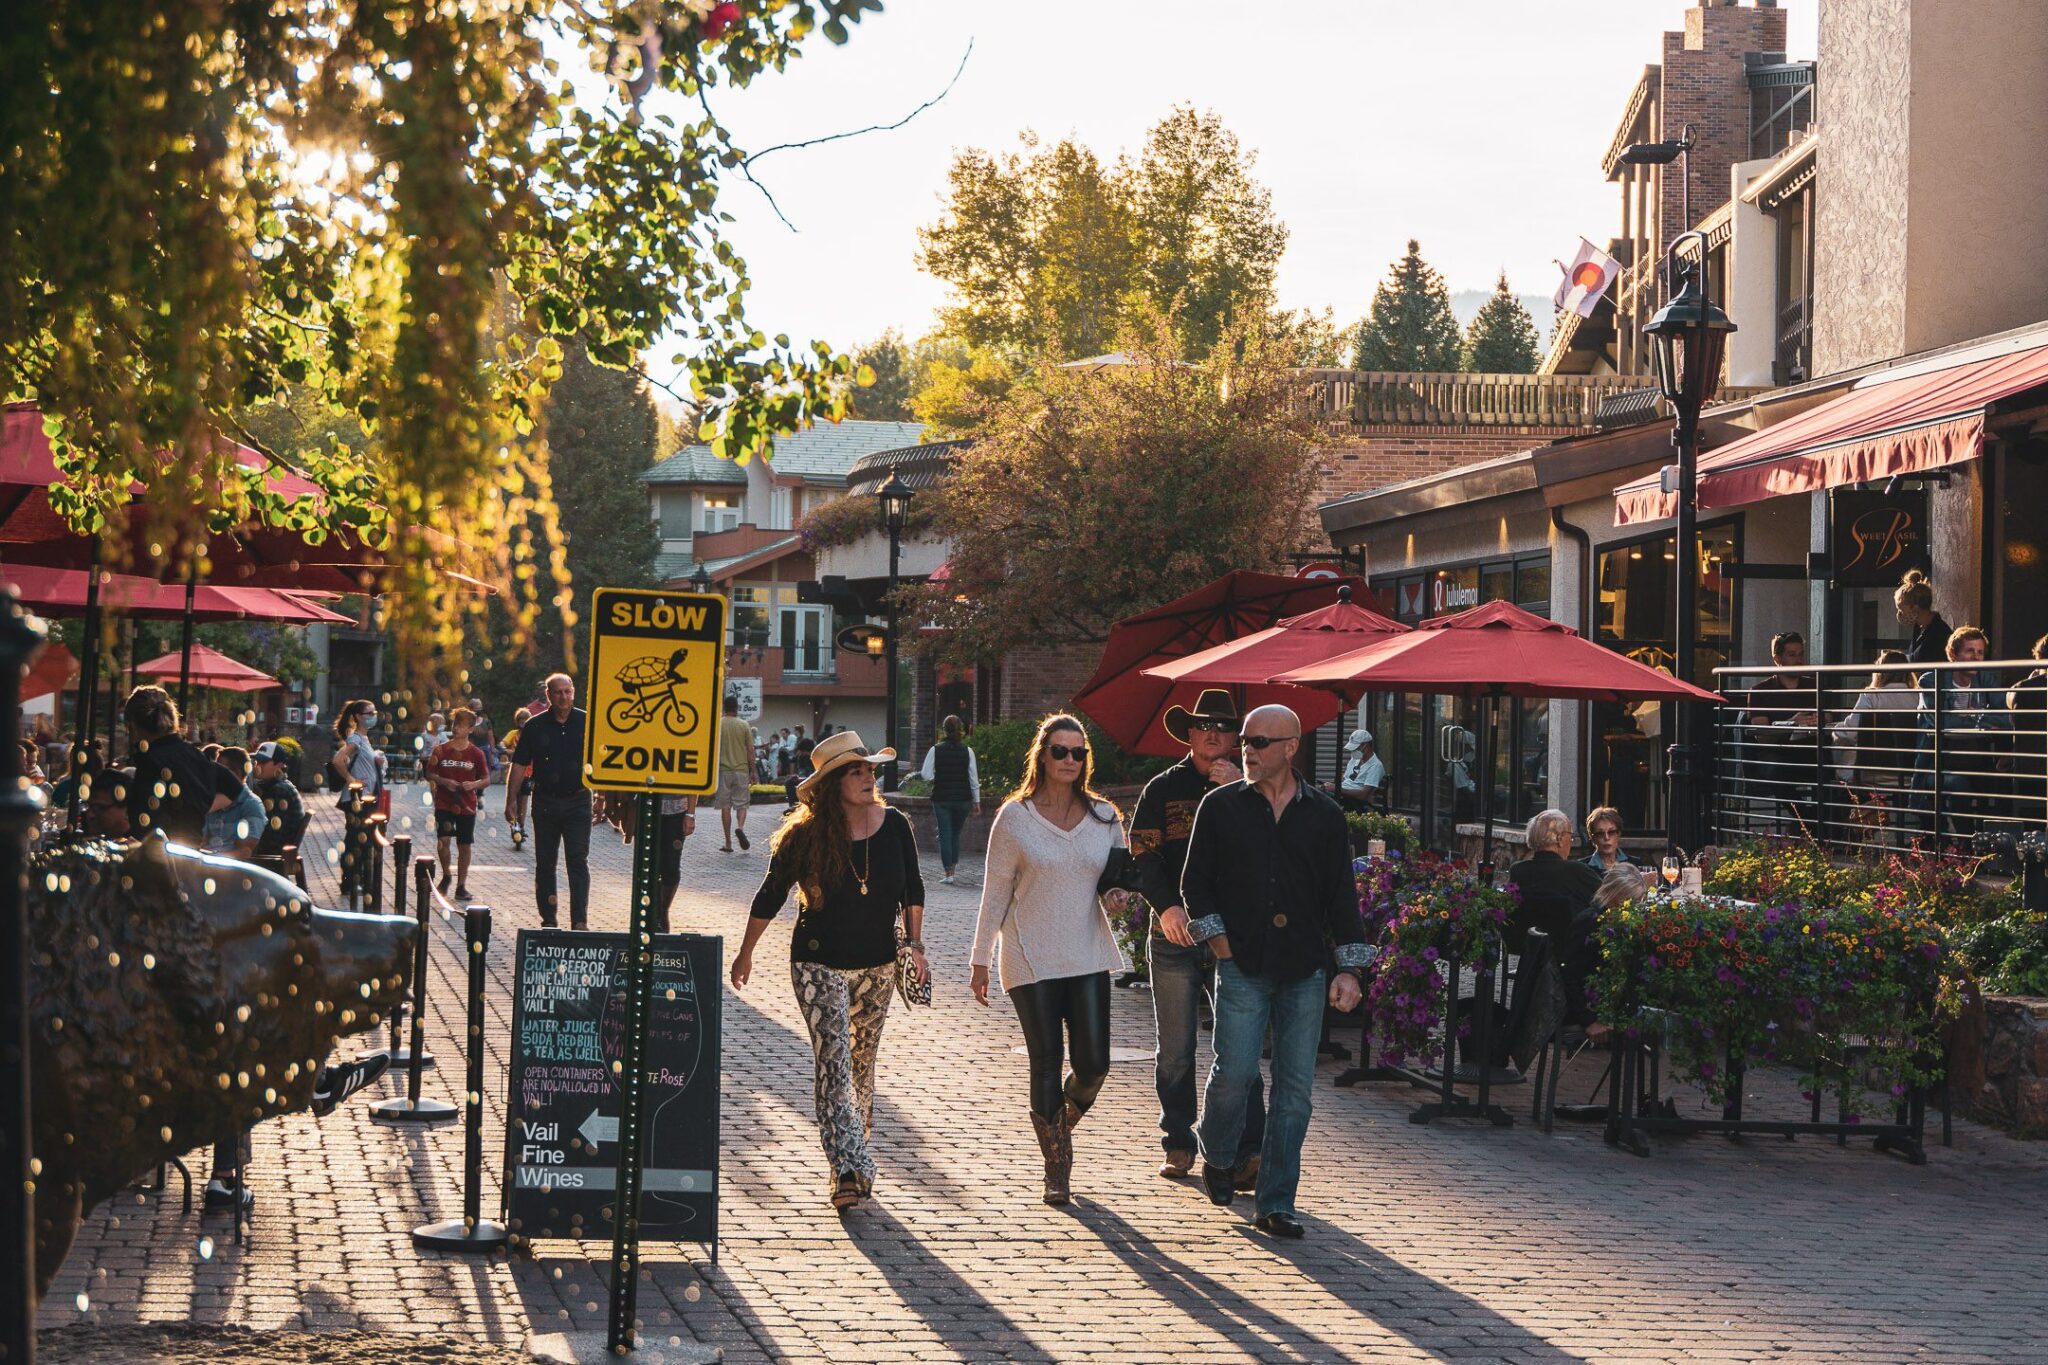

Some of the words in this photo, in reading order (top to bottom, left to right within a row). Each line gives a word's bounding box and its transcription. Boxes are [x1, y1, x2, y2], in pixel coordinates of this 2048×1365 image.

[611, 602, 707, 631] SLOW
[601, 746, 698, 774] ZONE
[525, 940, 567, 958] ENJOY
[569, 949, 576, 959] A
[577, 948, 597, 960] CAN
[598, 948, 613, 960] OF
[524, 958, 558, 972] COLD
[588, 961, 605, 975] OR
[652, 953, 686, 969] BEERS!
[523, 971, 552, 985] WINE
[651, 978, 694, 993] OCKTAILS!
[523, 984, 576, 1000] WALKING
[577, 988, 589, 1000] IN
[557, 1034, 576, 1047] RED
[557, 1047, 573, 1060] AS
[525, 1067, 548, 1078] OPEN
[551, 1066, 604, 1080] CONTAINERS
[523, 1079, 540, 1091] ARE
[541, 1080, 561, 1092] NOW
[561, 1080, 599, 1093] ALLOWED
[601, 1082, 611, 1095] IN
[522, 1122, 559, 1141] Vail
[522, 1144, 565, 1164] Fine
[521, 1167, 584, 1187] Wines
